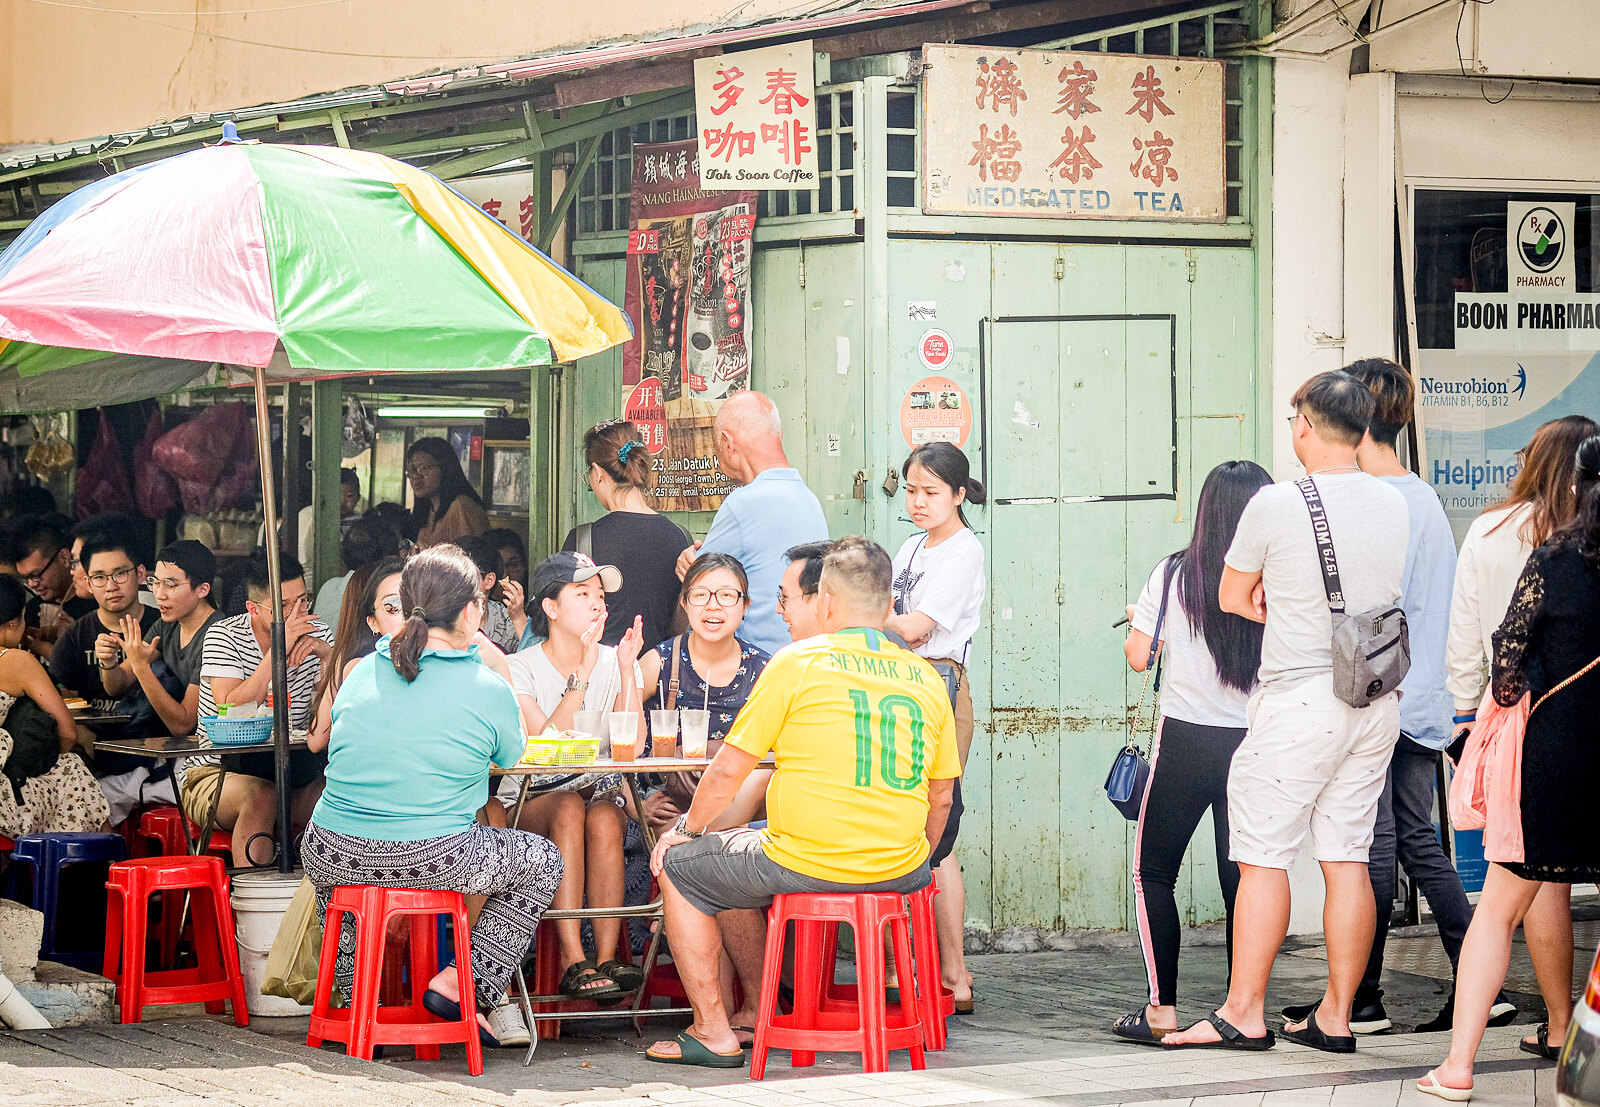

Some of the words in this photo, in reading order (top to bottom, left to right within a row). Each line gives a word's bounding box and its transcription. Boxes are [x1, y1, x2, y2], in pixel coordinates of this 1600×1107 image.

[711, 66, 809, 115] 多春
[704, 119, 811, 165] 咖啡
[706, 169, 732, 180] Toh
[736, 169, 770, 181] Soon
[773, 169, 813, 183] Coffee
[967, 187, 1110, 210] MEDICATED
[1134, 191, 1189, 212] TEA
[1516, 276, 1565, 287] PHARMACY
[1456, 302, 1508, 329] BOON
[1420, 377, 1508, 394] Neurobion
[1460, 395, 1474, 408] B1,
[1476, 395, 1490, 408] B6,
[1492, 395, 1509, 407] B12
[628, 409, 659, 420] AVAILABLE
[651, 458, 666, 473] 23,
[684, 455, 711, 470] Datuk
[693, 474, 714, 484] Town,
[1308, 503, 1332, 545] WOLF
[830, 652, 900, 679] NEYMAR
[904, 664, 925, 685] JR
[848, 689, 925, 790] 10
